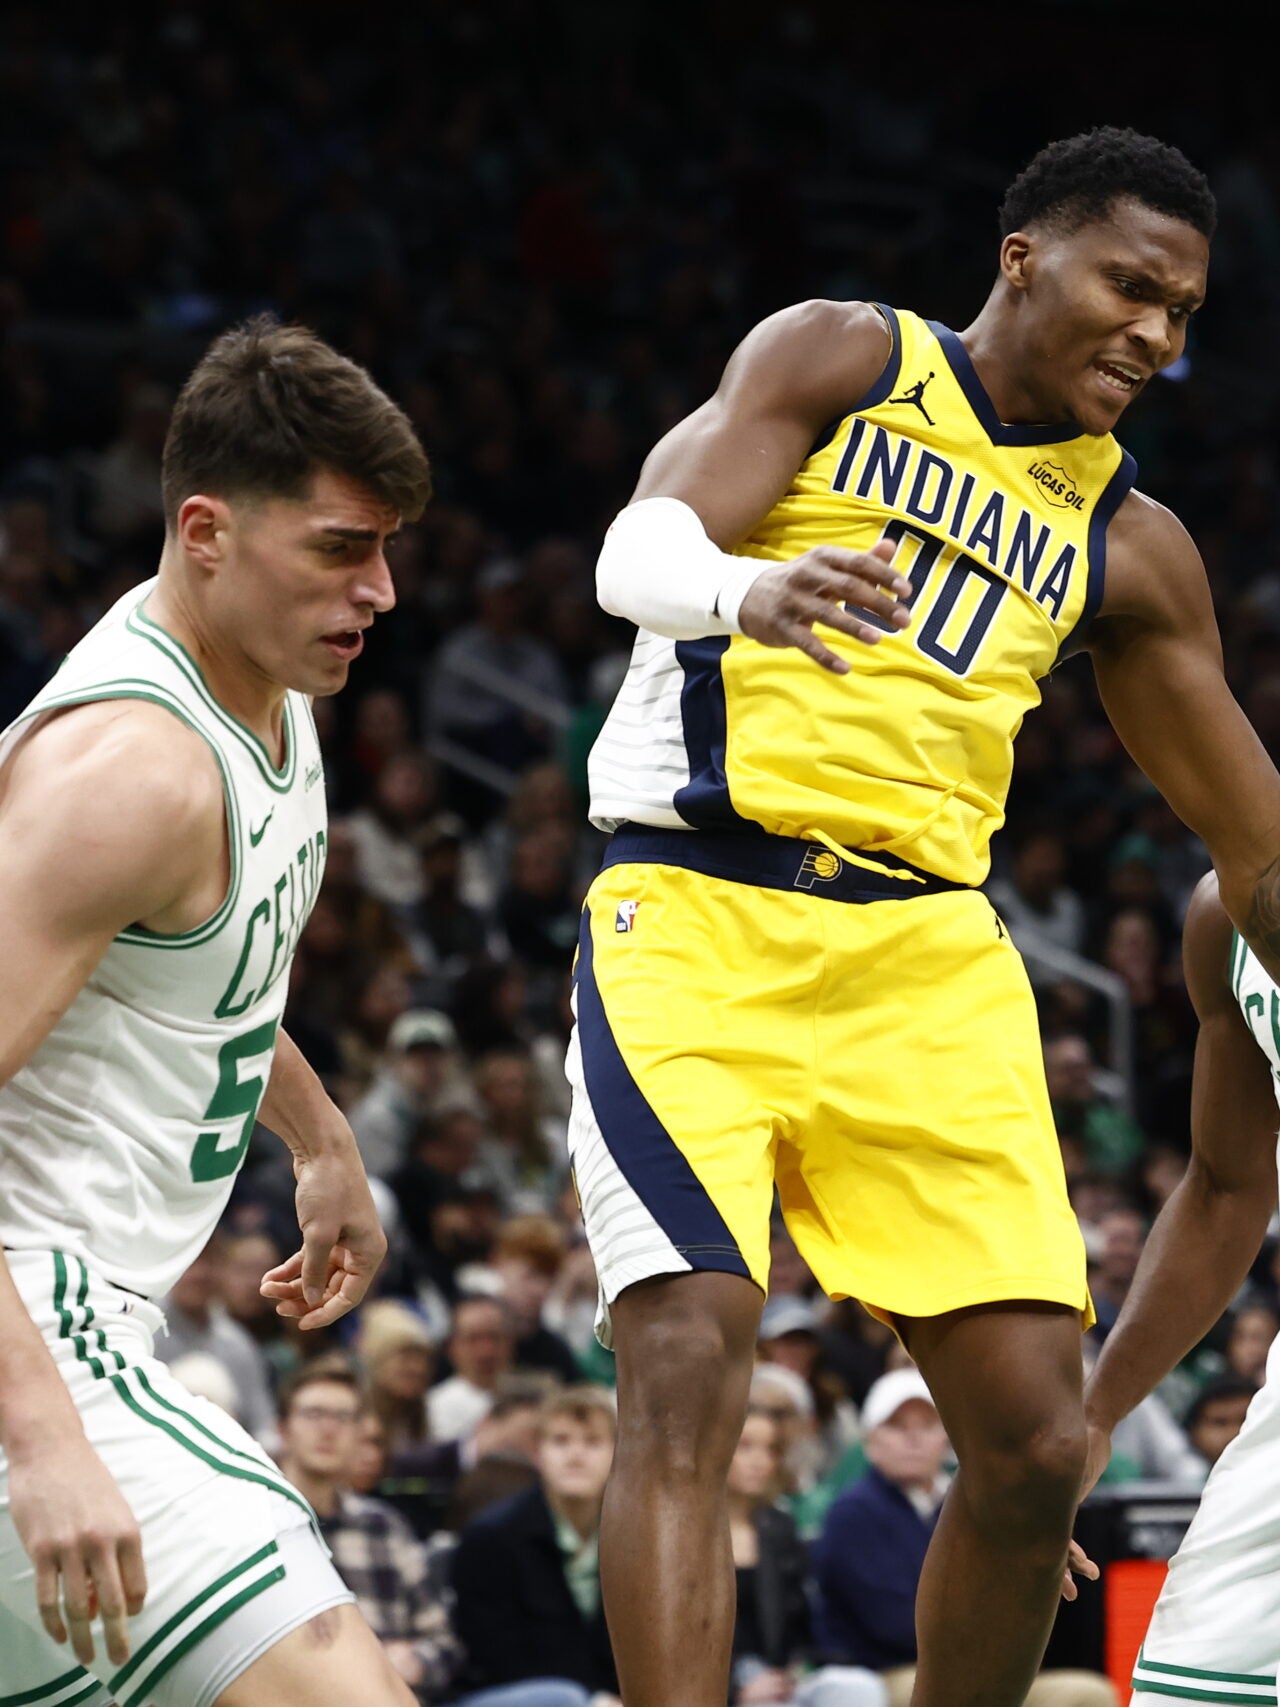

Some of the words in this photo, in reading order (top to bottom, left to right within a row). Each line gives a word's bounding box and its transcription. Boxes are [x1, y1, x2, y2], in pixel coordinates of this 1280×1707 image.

[830, 416, 1077, 624] INDIANA
[1027, 462, 1066, 496] LUCAS
[1064, 490, 1085, 512] OIL
[842, 518, 1011, 680] 00
[190, 1014, 281, 1184] 5
